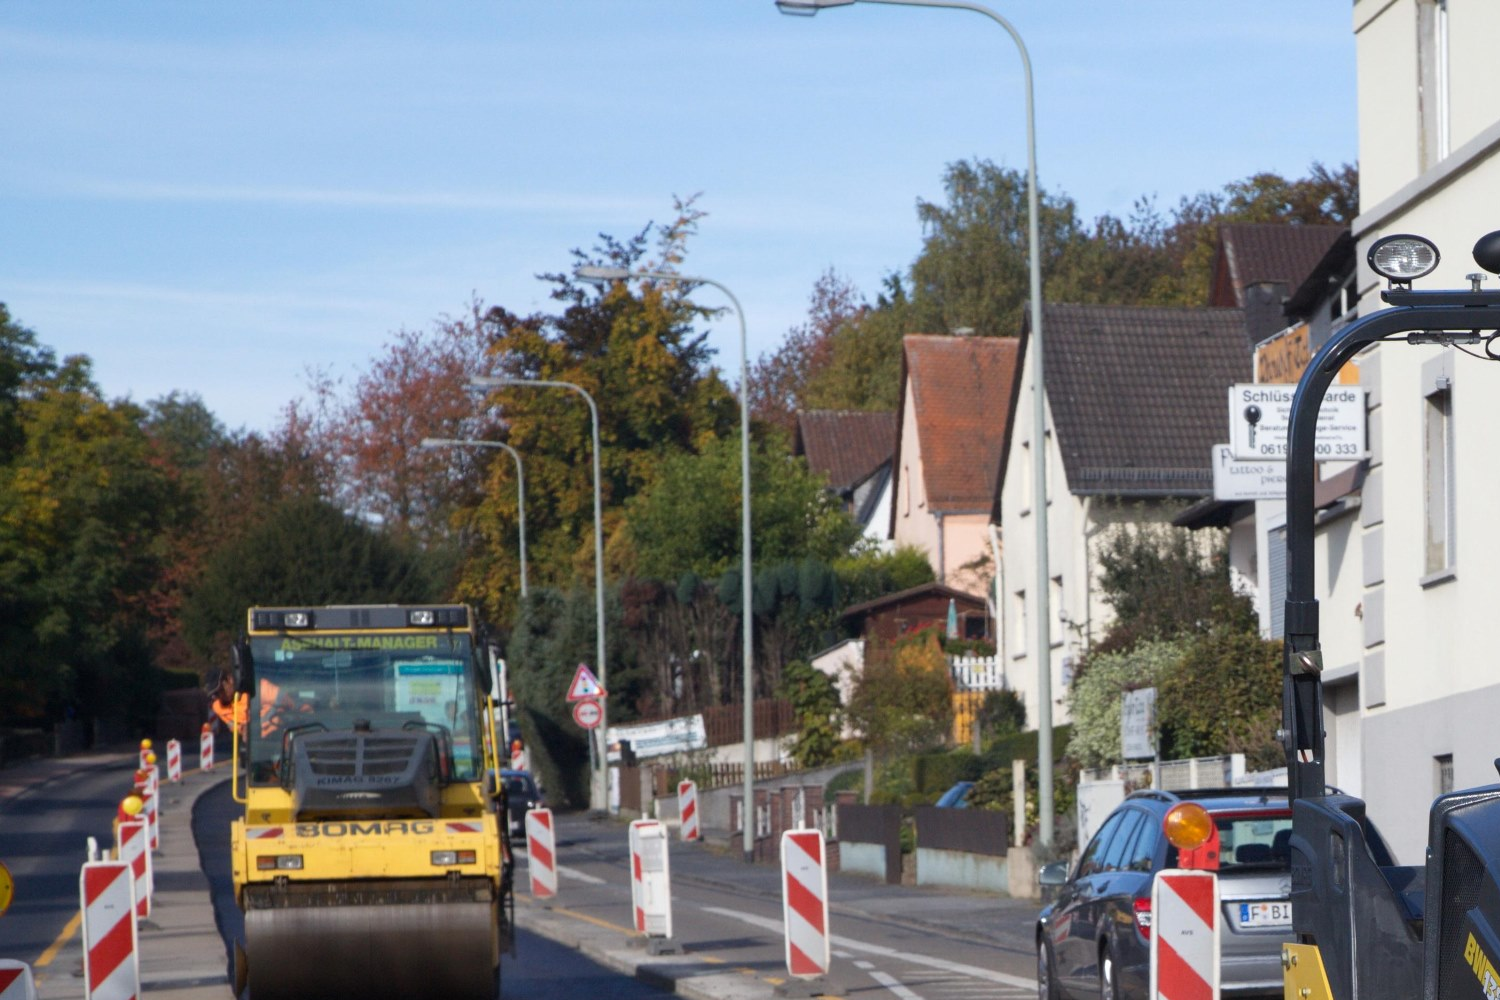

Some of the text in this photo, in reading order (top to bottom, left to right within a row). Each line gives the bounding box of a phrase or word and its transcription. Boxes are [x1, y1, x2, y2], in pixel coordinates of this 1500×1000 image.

[1243, 389, 1356, 403] Schlüssarde
[1335, 443, 1357, 454] 333
[295, 821, 435, 838] BOMAG
